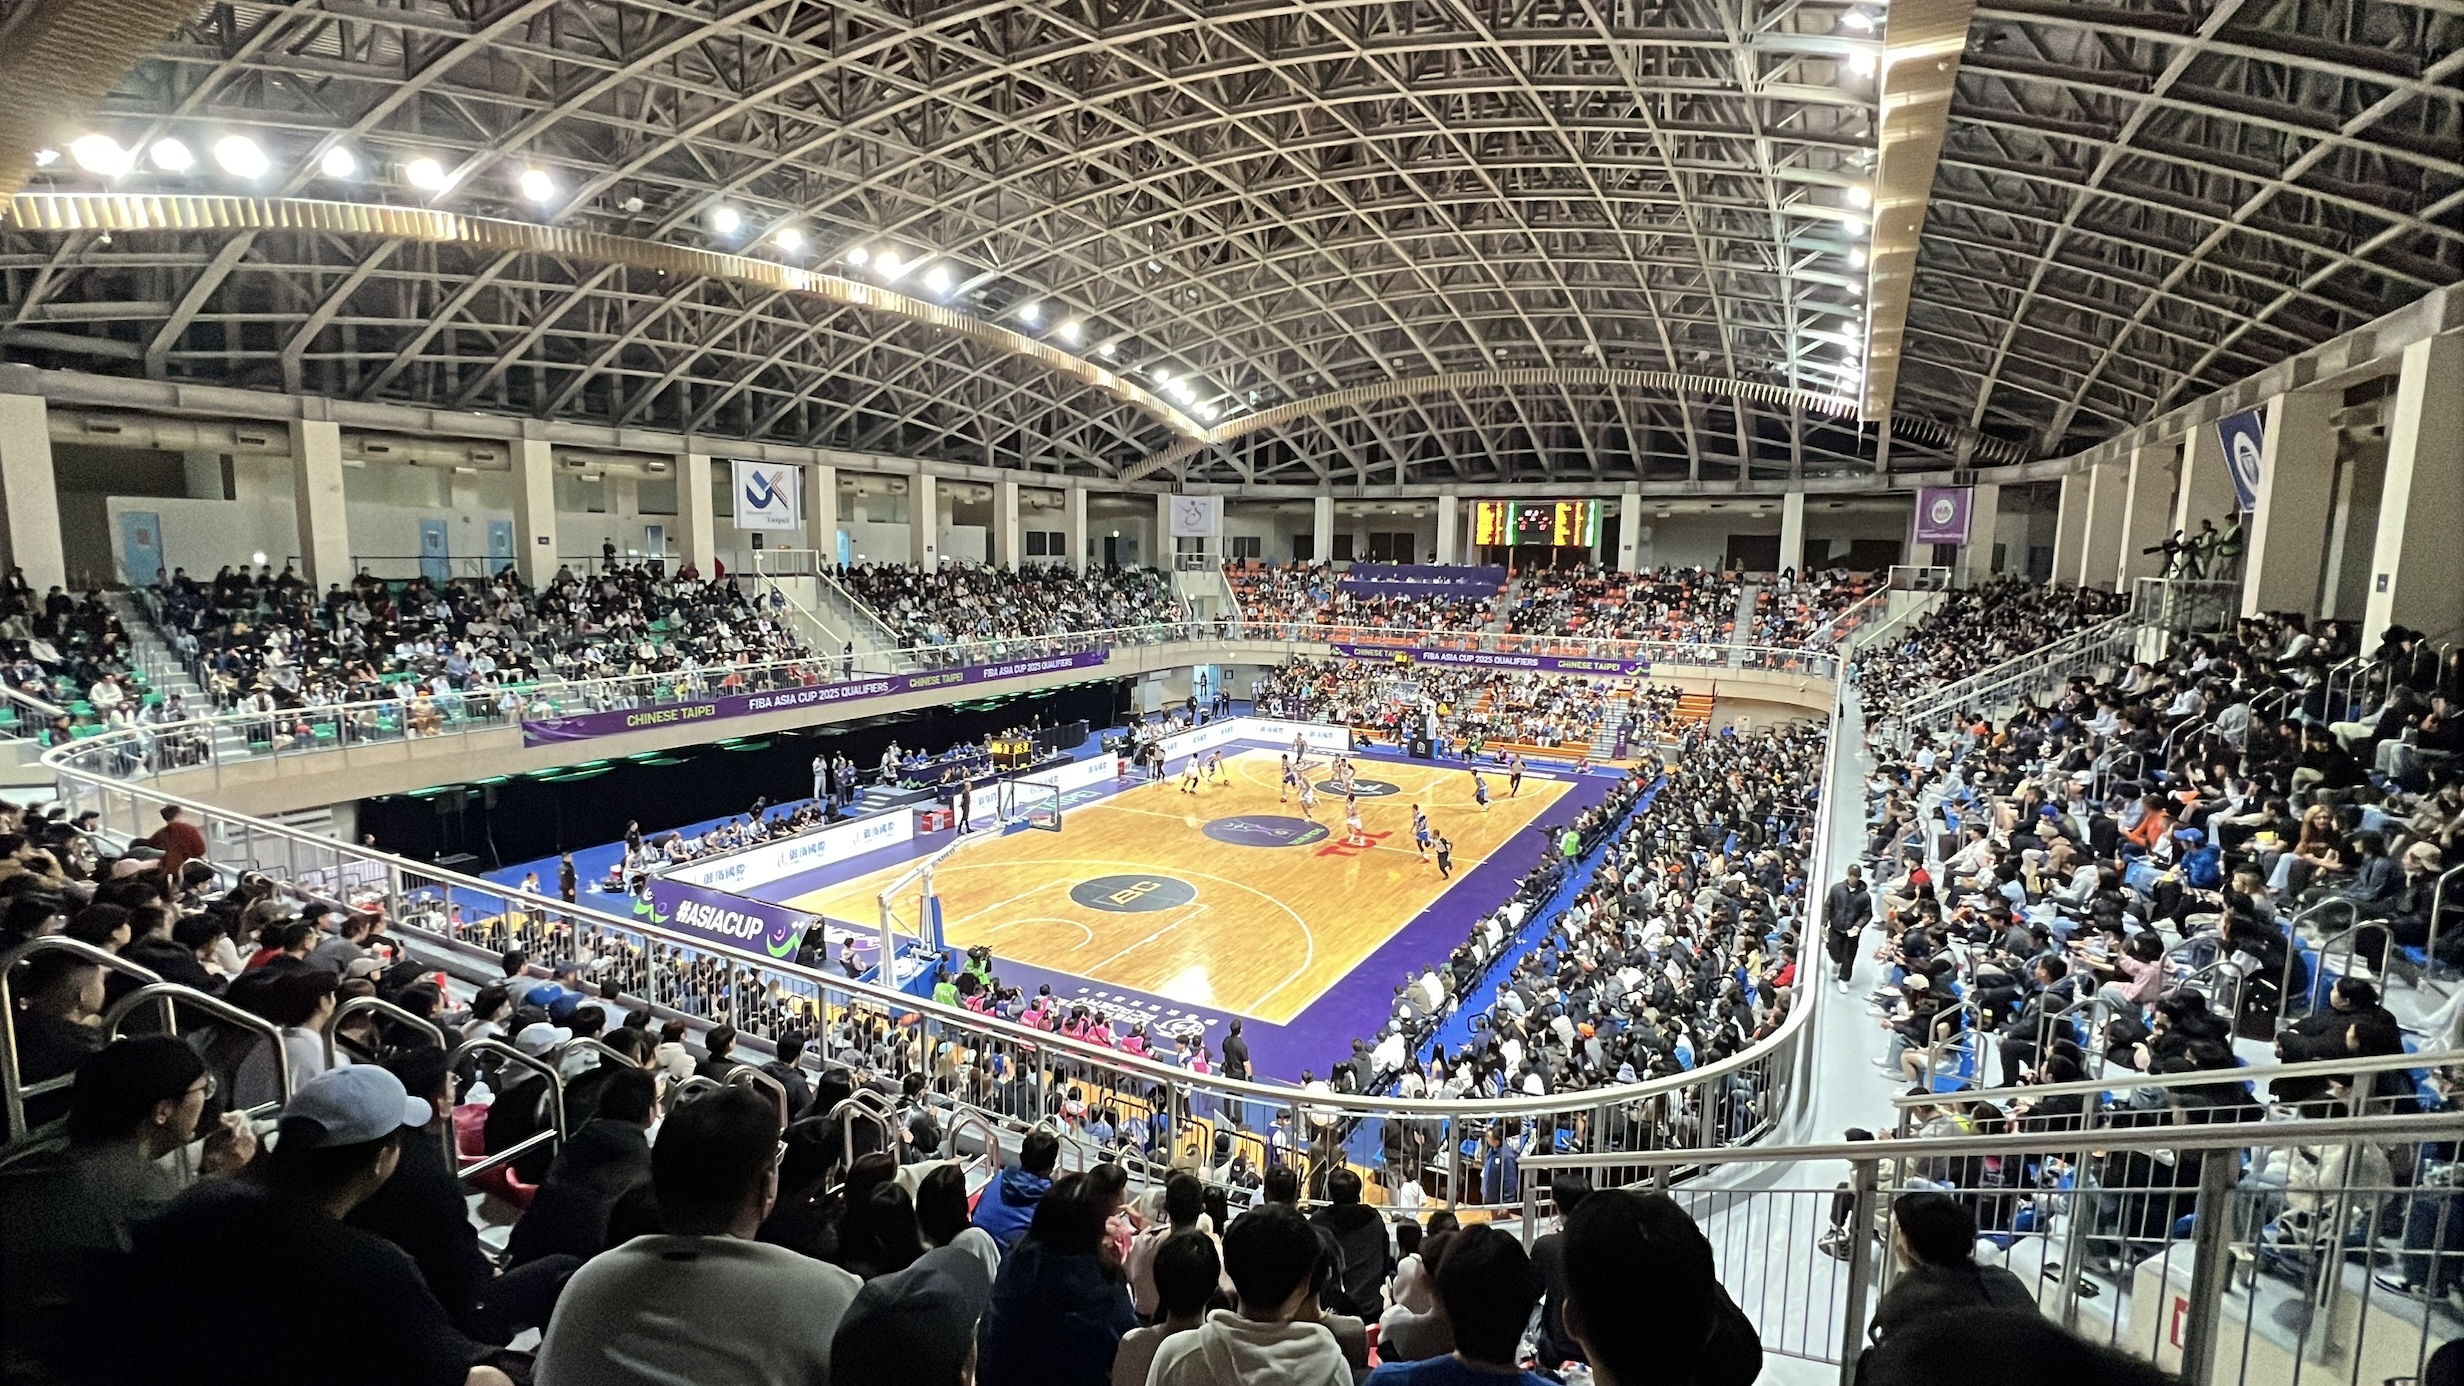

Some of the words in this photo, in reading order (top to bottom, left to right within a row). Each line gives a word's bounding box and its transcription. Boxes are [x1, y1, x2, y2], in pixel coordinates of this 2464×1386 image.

[1354, 648, 1383, 657] CHINESE
[1423, 652, 1440, 660] FIBA
[1440, 653, 1457, 662] ASIA
[1459, 654, 1474, 662] CUP
[1475, 655, 1493, 664] 2025
[1494, 655, 1539, 667] QUALIFIERS
[983, 668, 999, 679] FIBA
[999, 666, 1014, 677] ASIA
[1014, 664, 1027, 674] CUP
[1027, 663, 1041, 673] 2025
[1041, 658, 1073, 671] QUALIFIERS
[1558, 660, 1593, 670] CHINESE
[1594, 662, 1621, 672] TAIPEI
[909, 676, 941, 688] CHINESE
[942, 672, 964, 683] TAIPEI
[749, 698, 773, 711] FIBA
[774, 694, 798, 707] ASIA
[798, 691, 818, 704] CUP
[818, 688, 840, 701] 2025
[841, 681, 890, 698] QUALIFIERS
[626, 711, 678, 727] CHINESE
[681, 704, 716, 720] TAIPEI
[676, 899, 764, 941] #ASIACUP
